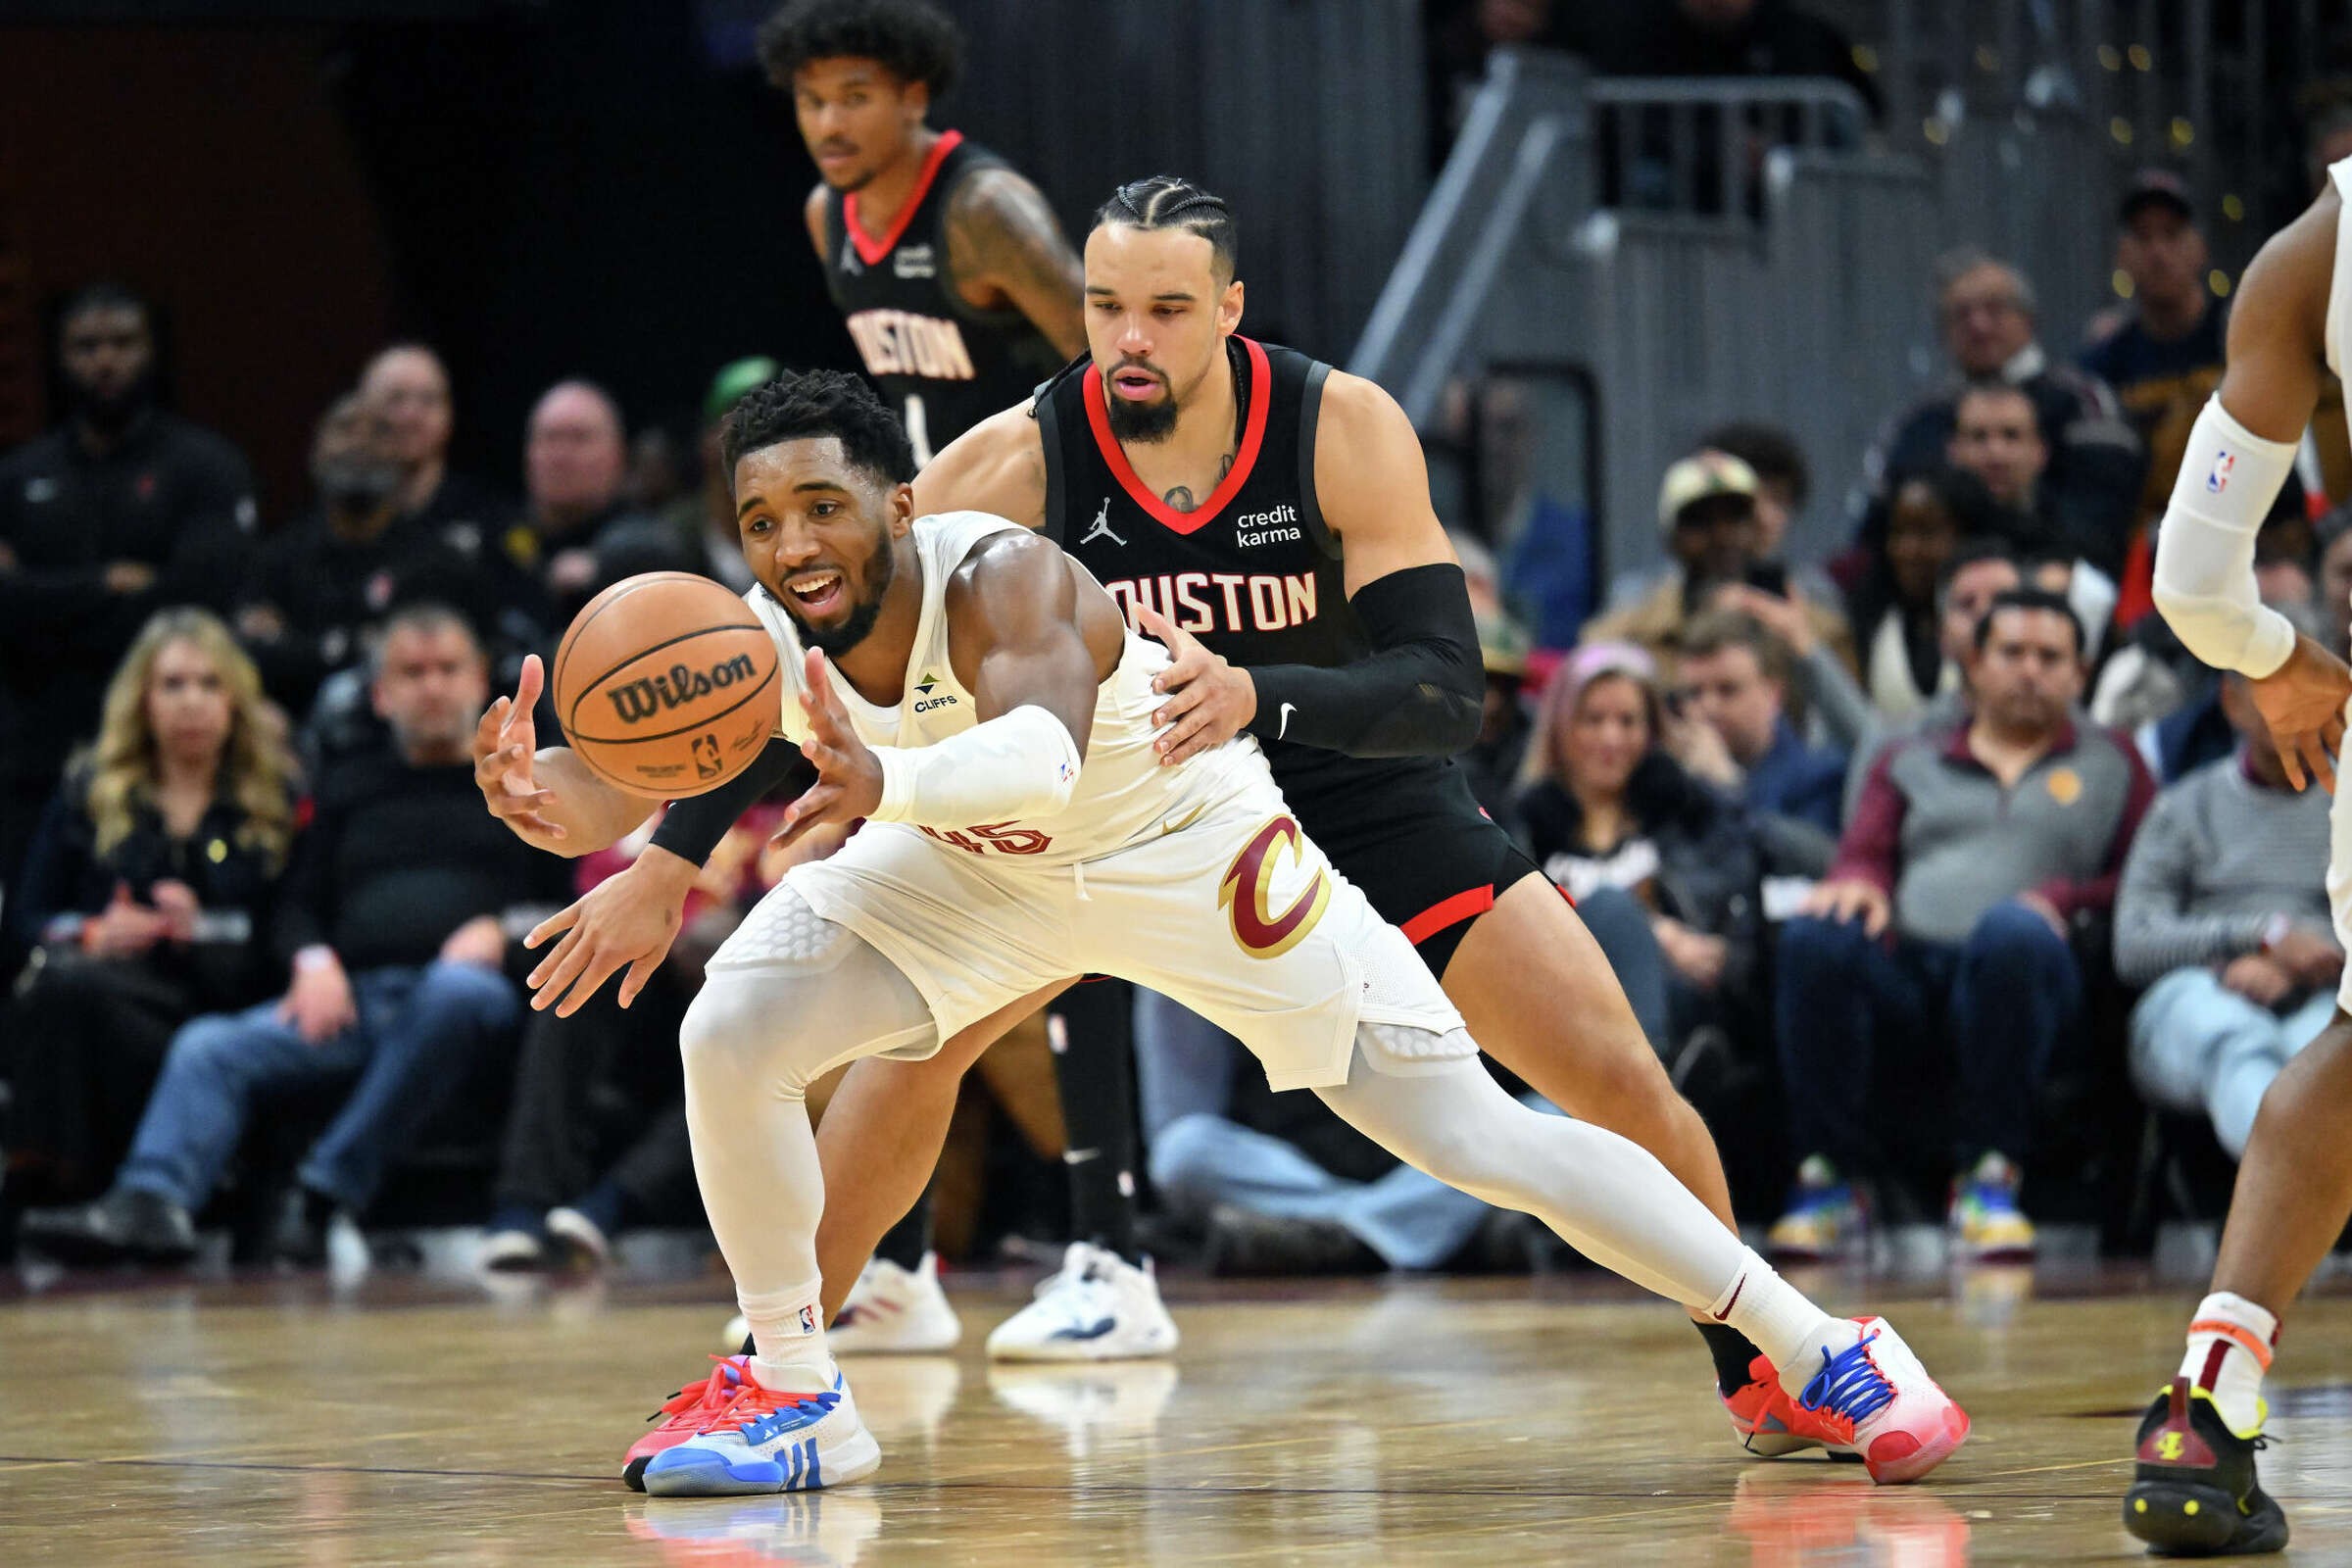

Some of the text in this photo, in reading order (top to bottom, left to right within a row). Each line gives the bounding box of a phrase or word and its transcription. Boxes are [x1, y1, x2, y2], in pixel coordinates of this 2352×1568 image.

[1238, 505, 1297, 528] credit
[1237, 527, 1301, 548] karma
[1104, 571, 1317, 637] OUSTON
[607, 653, 757, 724] Wilson
[914, 695, 957, 713] CLIFFS
